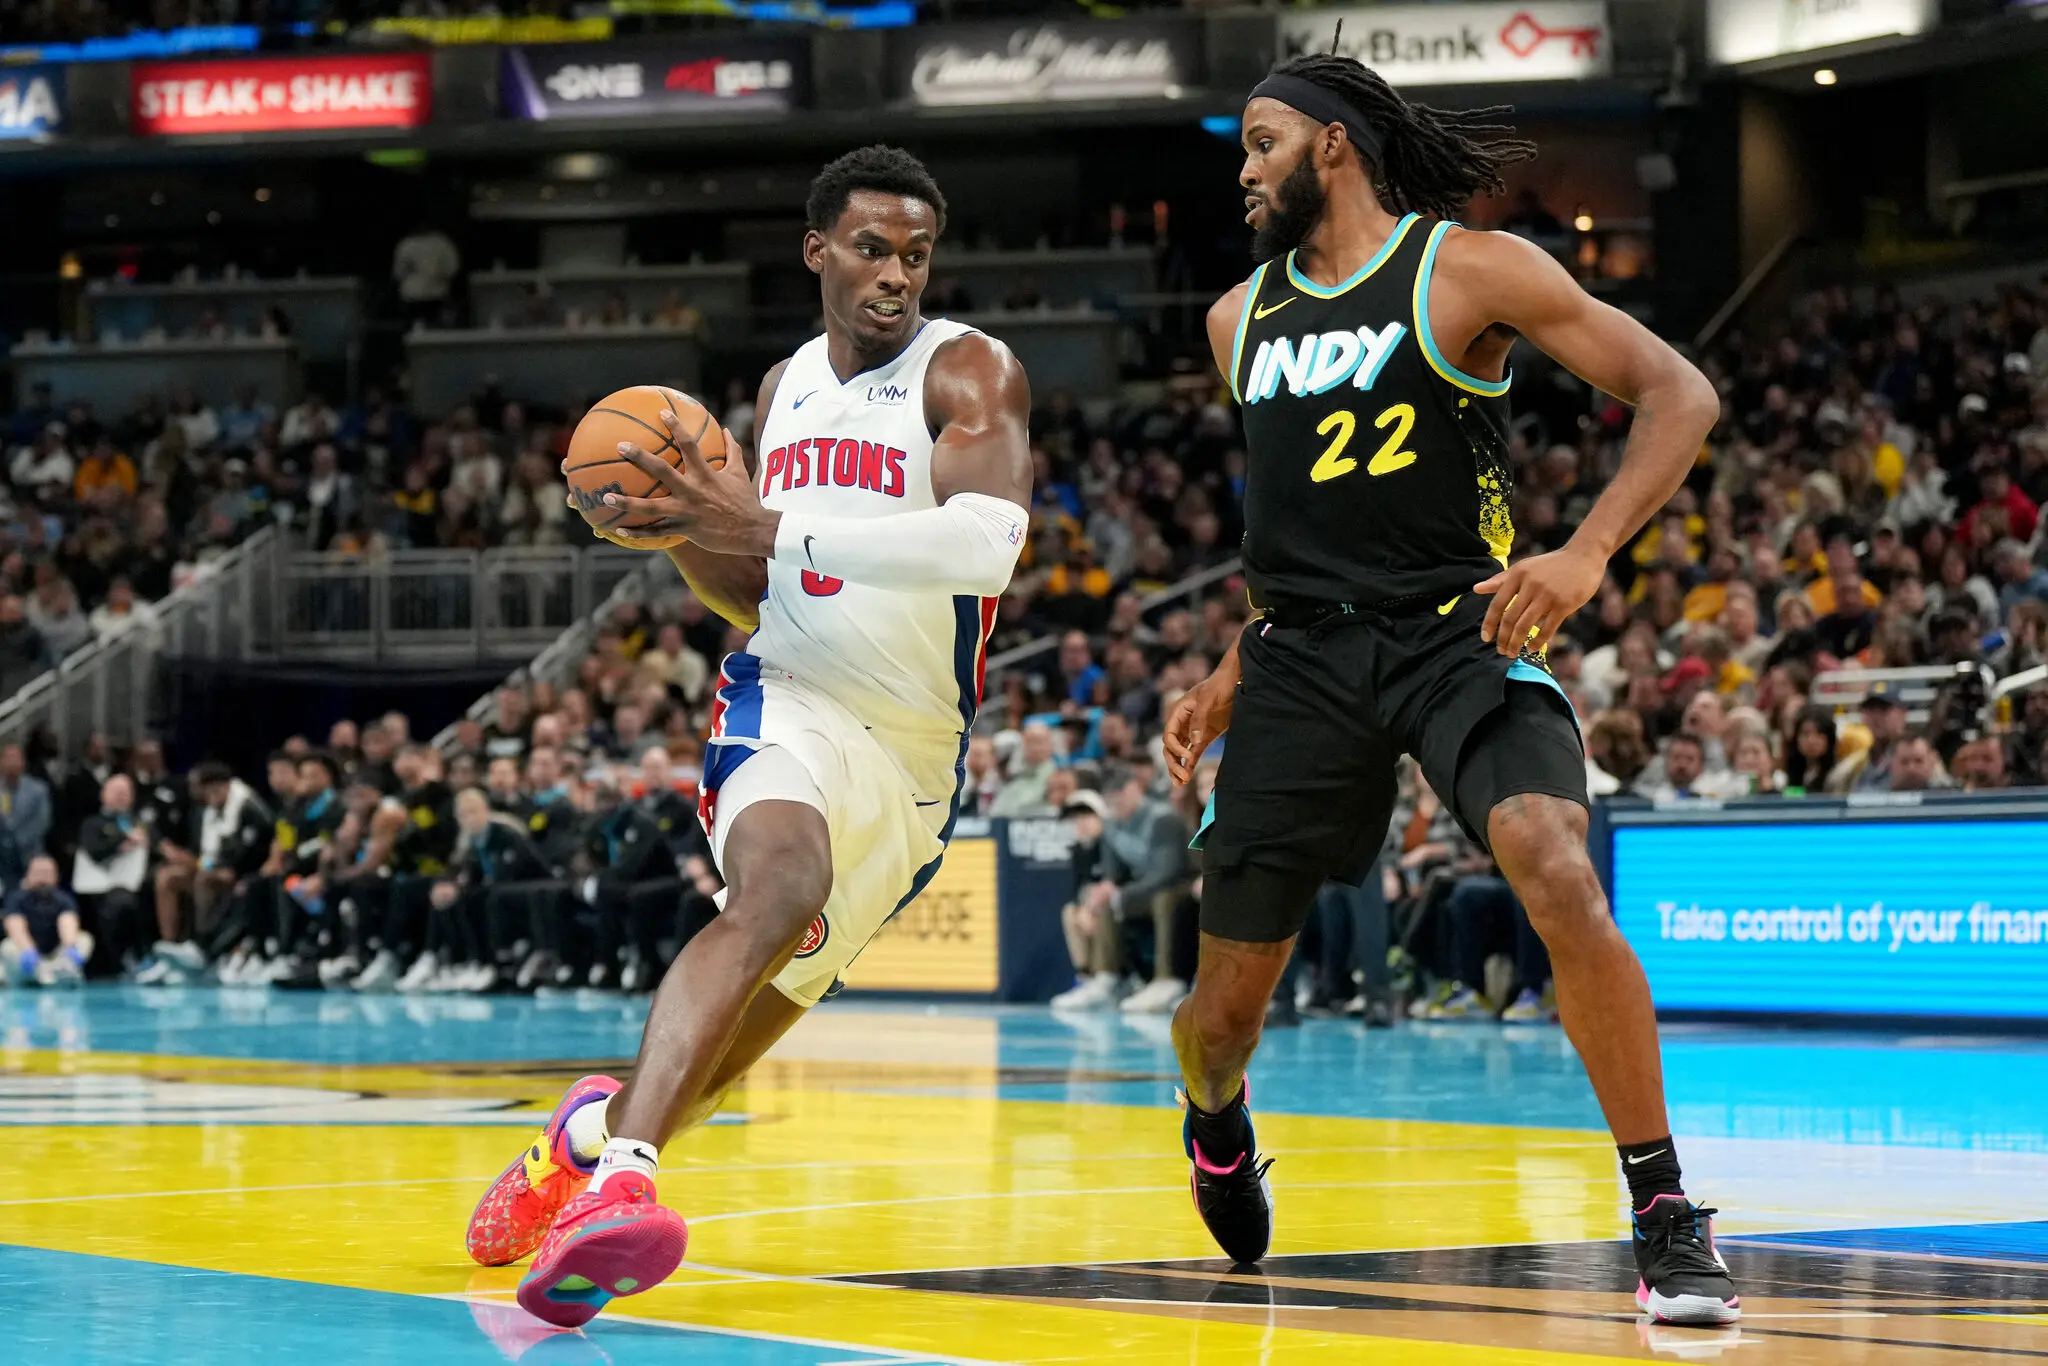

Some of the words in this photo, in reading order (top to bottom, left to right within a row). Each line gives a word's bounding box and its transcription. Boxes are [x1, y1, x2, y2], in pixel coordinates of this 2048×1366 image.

[139, 78, 259, 119] STEAK
[289, 70, 419, 113] SHAKE
[1245, 321, 1408, 404] INDY
[867, 385, 908, 401] UWM
[762, 437, 907, 500] PISTONS
[1310, 403, 1417, 483] 22
[1656, 902, 1728, 941] Take
[1732, 902, 1844, 943] control
[1847, 901, 1884, 942] of
[1886, 906, 1963, 952] your
